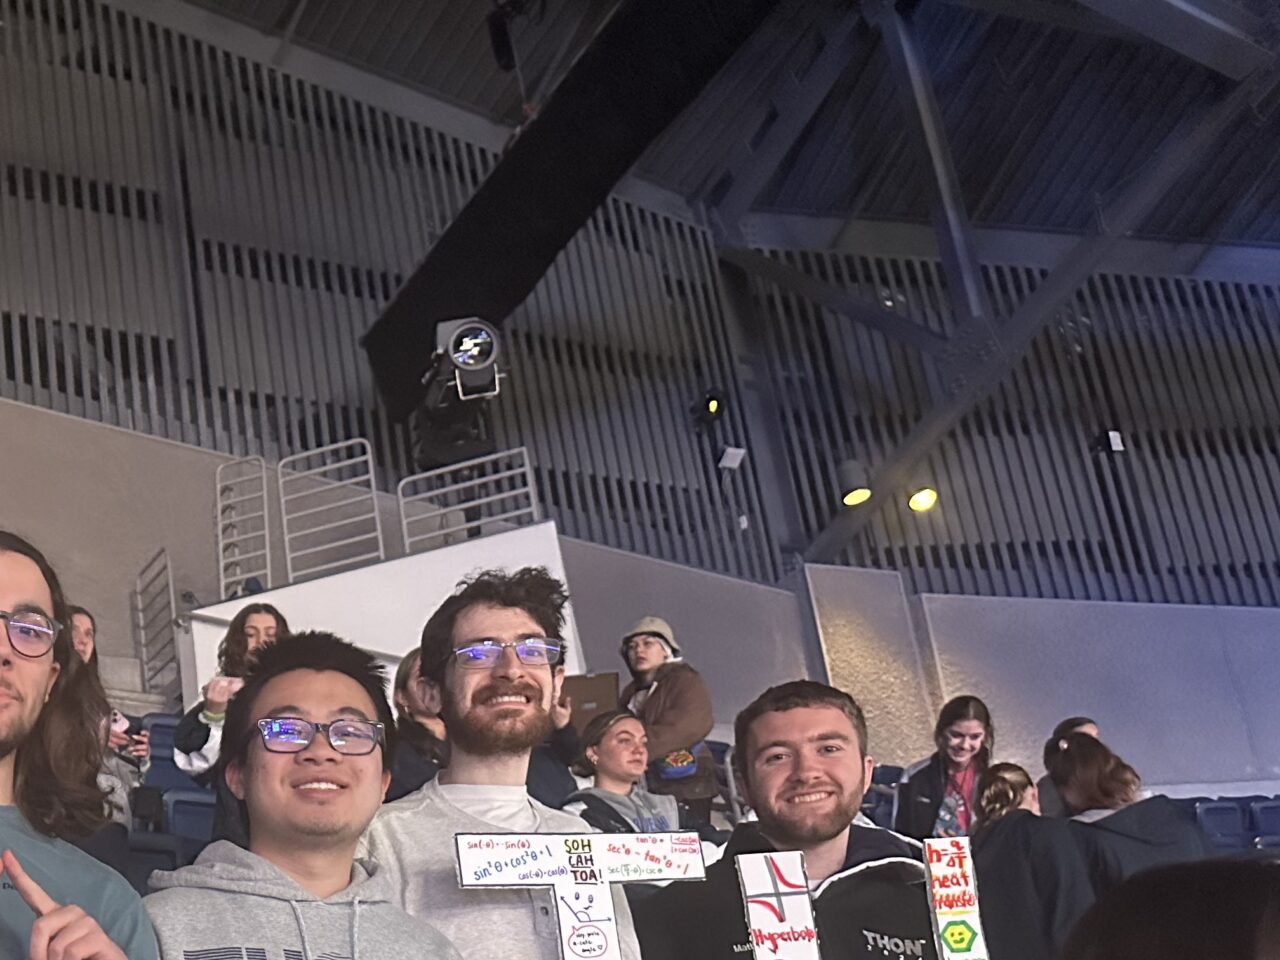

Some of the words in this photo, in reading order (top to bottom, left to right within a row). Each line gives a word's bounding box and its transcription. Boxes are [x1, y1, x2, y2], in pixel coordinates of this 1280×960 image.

[564, 839, 592, 853] SOH
[568, 854, 594, 868] CAH
[862, 929, 924, 956] THON
